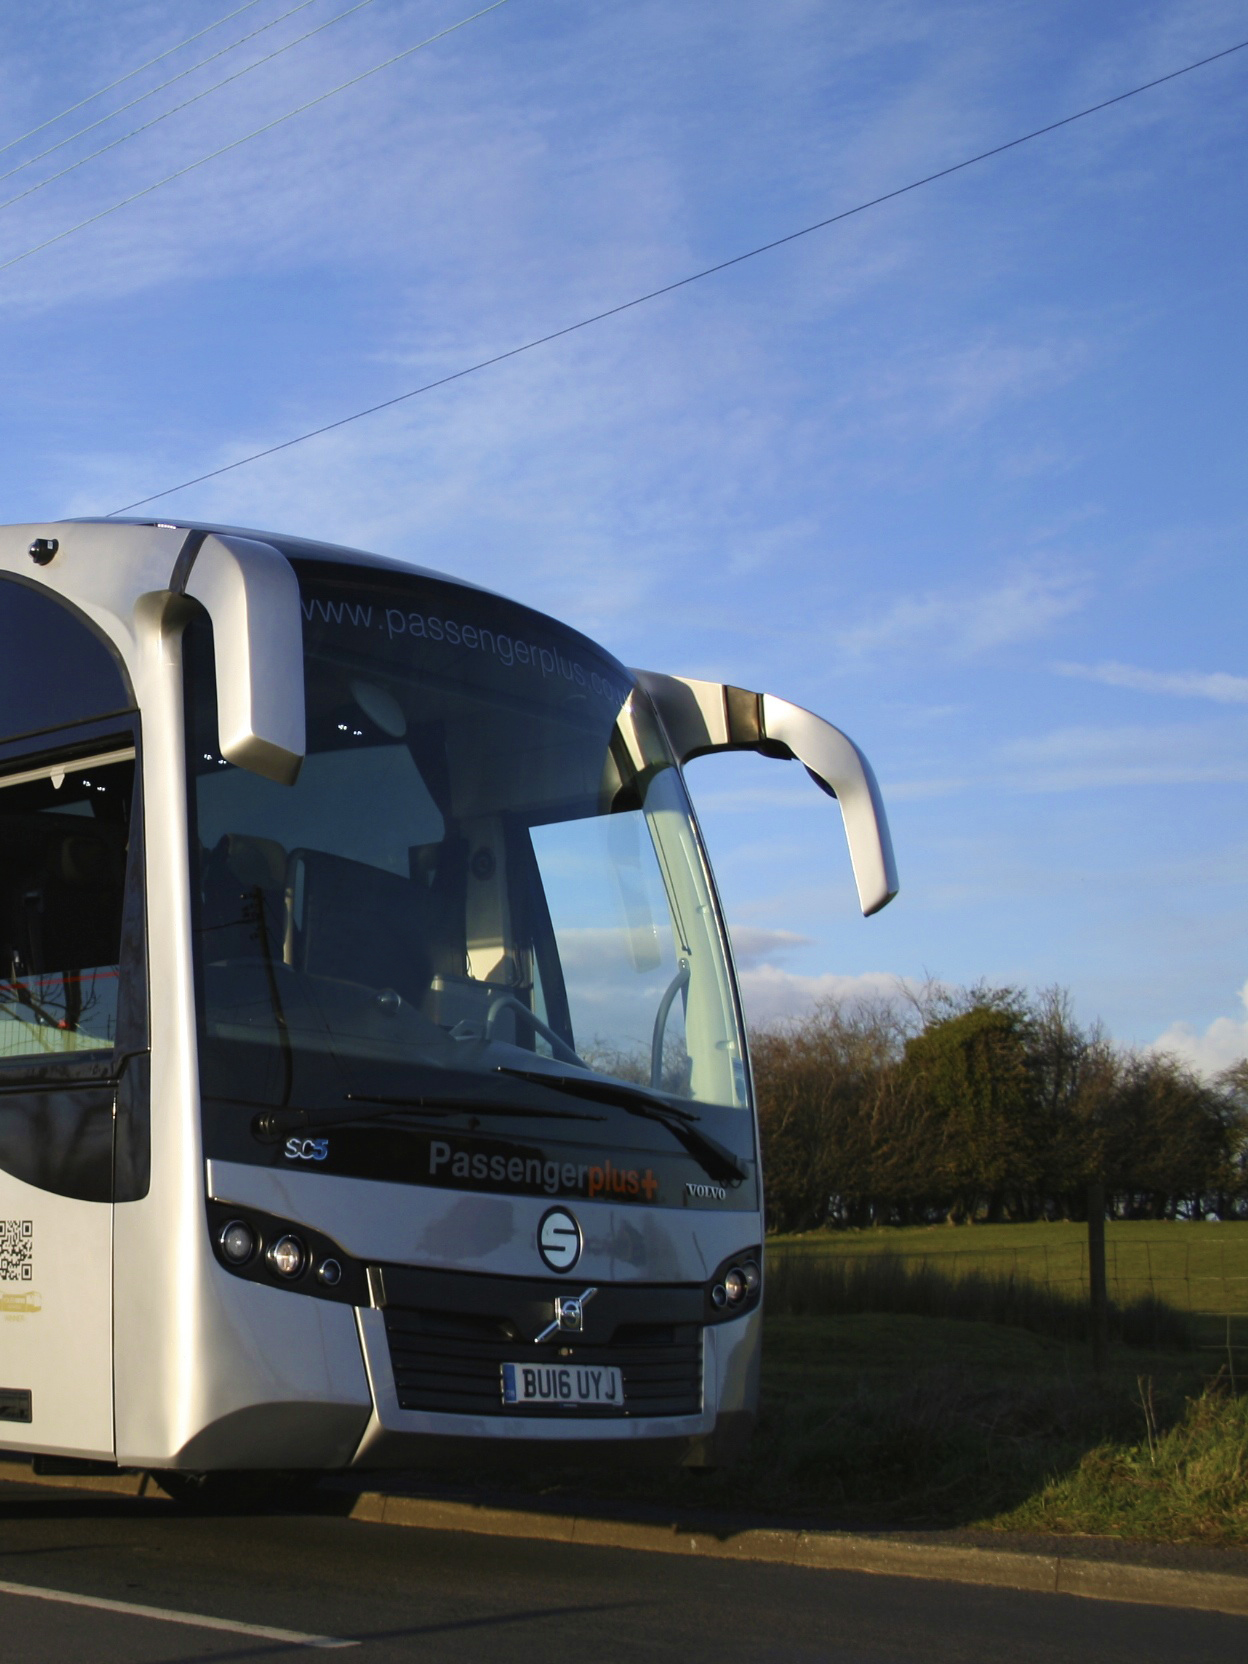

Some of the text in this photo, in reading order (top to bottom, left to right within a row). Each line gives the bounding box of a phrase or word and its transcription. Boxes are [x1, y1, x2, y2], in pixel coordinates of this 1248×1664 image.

[284, 1137, 328, 1161] SC5
[685, 1182, 727, 1201] VOLVO
[522, 1368, 617, 1400] BU16 UYJ
